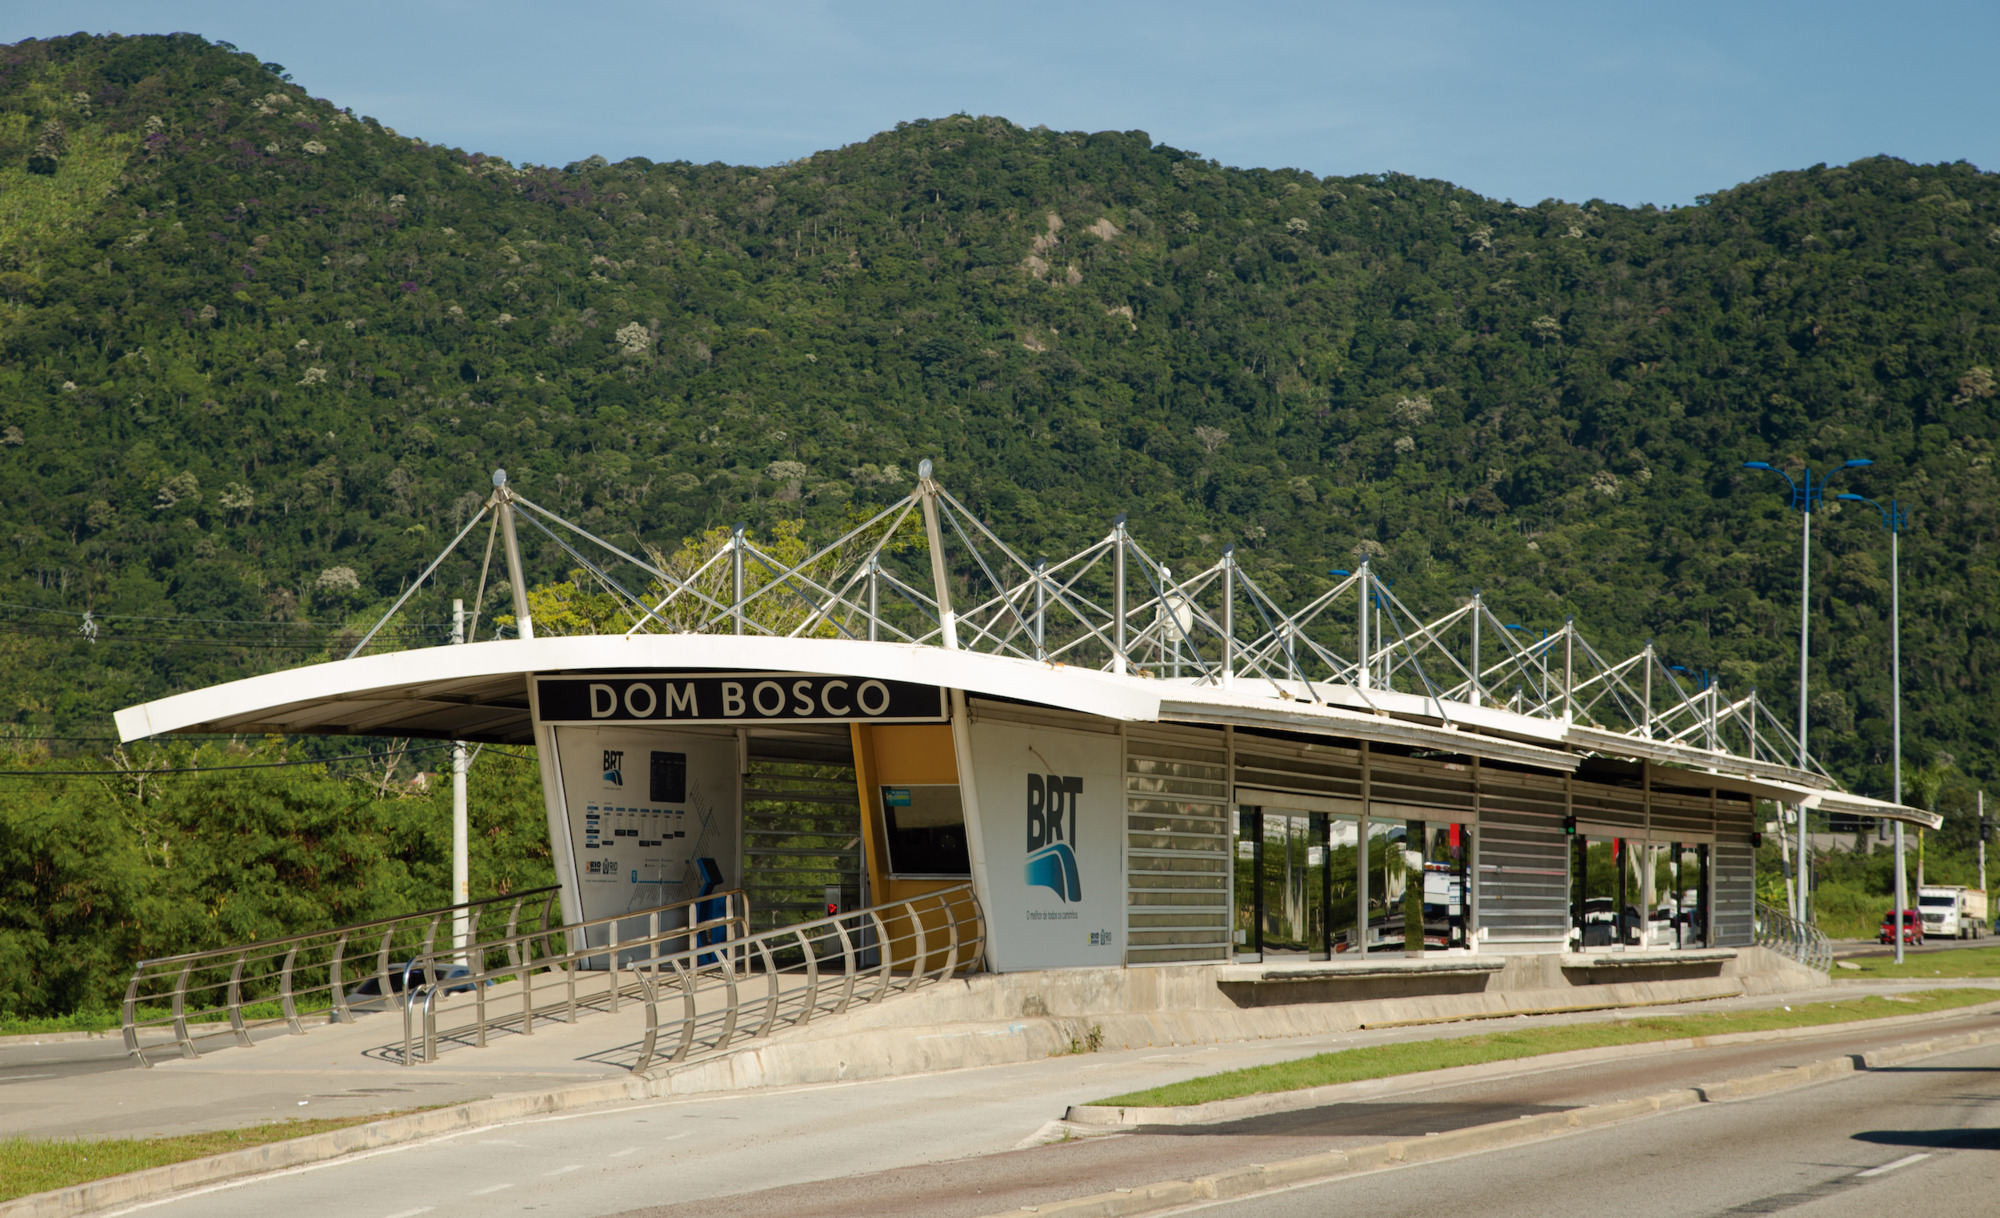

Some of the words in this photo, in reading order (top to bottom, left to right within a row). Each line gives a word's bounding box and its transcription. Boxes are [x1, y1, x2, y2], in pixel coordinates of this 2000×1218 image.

[589, 682, 699, 718] DOM
[721, 679, 890, 716] BOSCO
[604, 749, 623, 771] BRT
[1027, 773, 1083, 854] BRT
